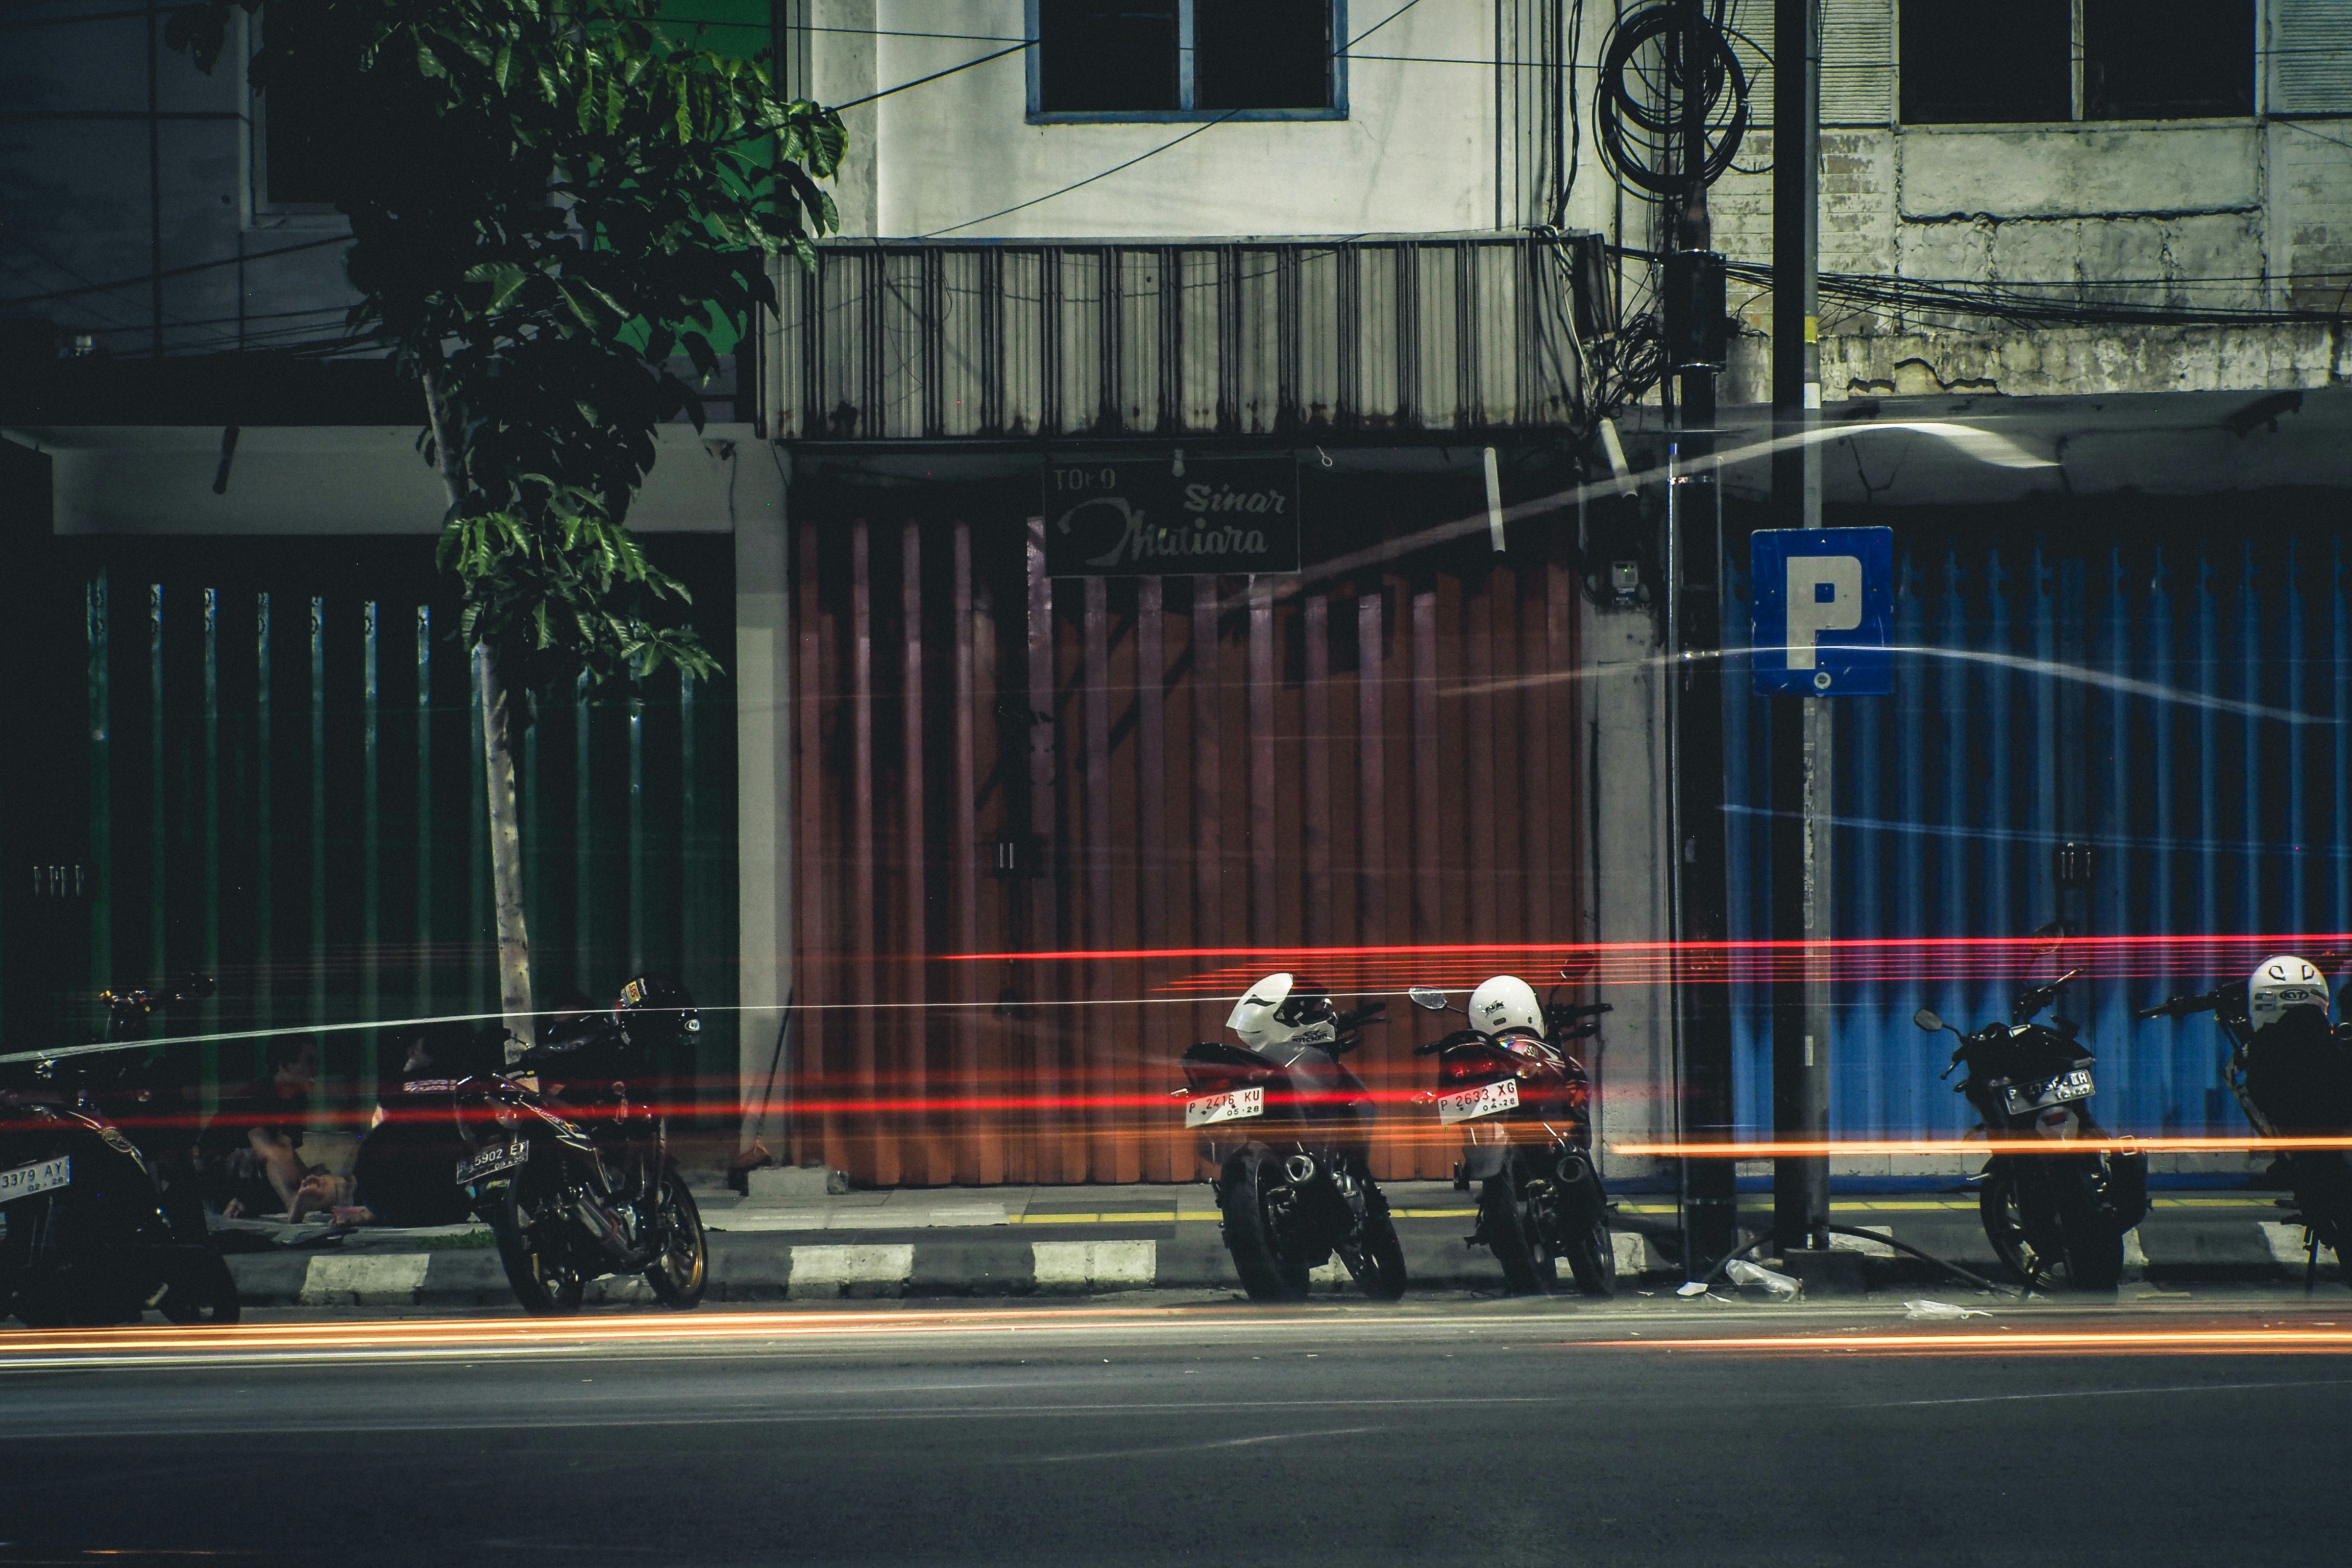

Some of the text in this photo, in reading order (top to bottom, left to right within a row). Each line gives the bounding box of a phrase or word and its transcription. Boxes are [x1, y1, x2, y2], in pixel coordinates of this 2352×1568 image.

[1184, 483, 1285, 514] Sinar
[1787, 556, 1862, 670] P
[1189, 1102, 1195, 1113] P
[1245, 1090, 1260, 1102] KU
[1441, 1099, 1448, 1111] P
[1456, 1088, 1489, 1107] 2633
[474, 1149, 503, 1166] 5902
[2, 1162, 62, 1189] 3379 AY
